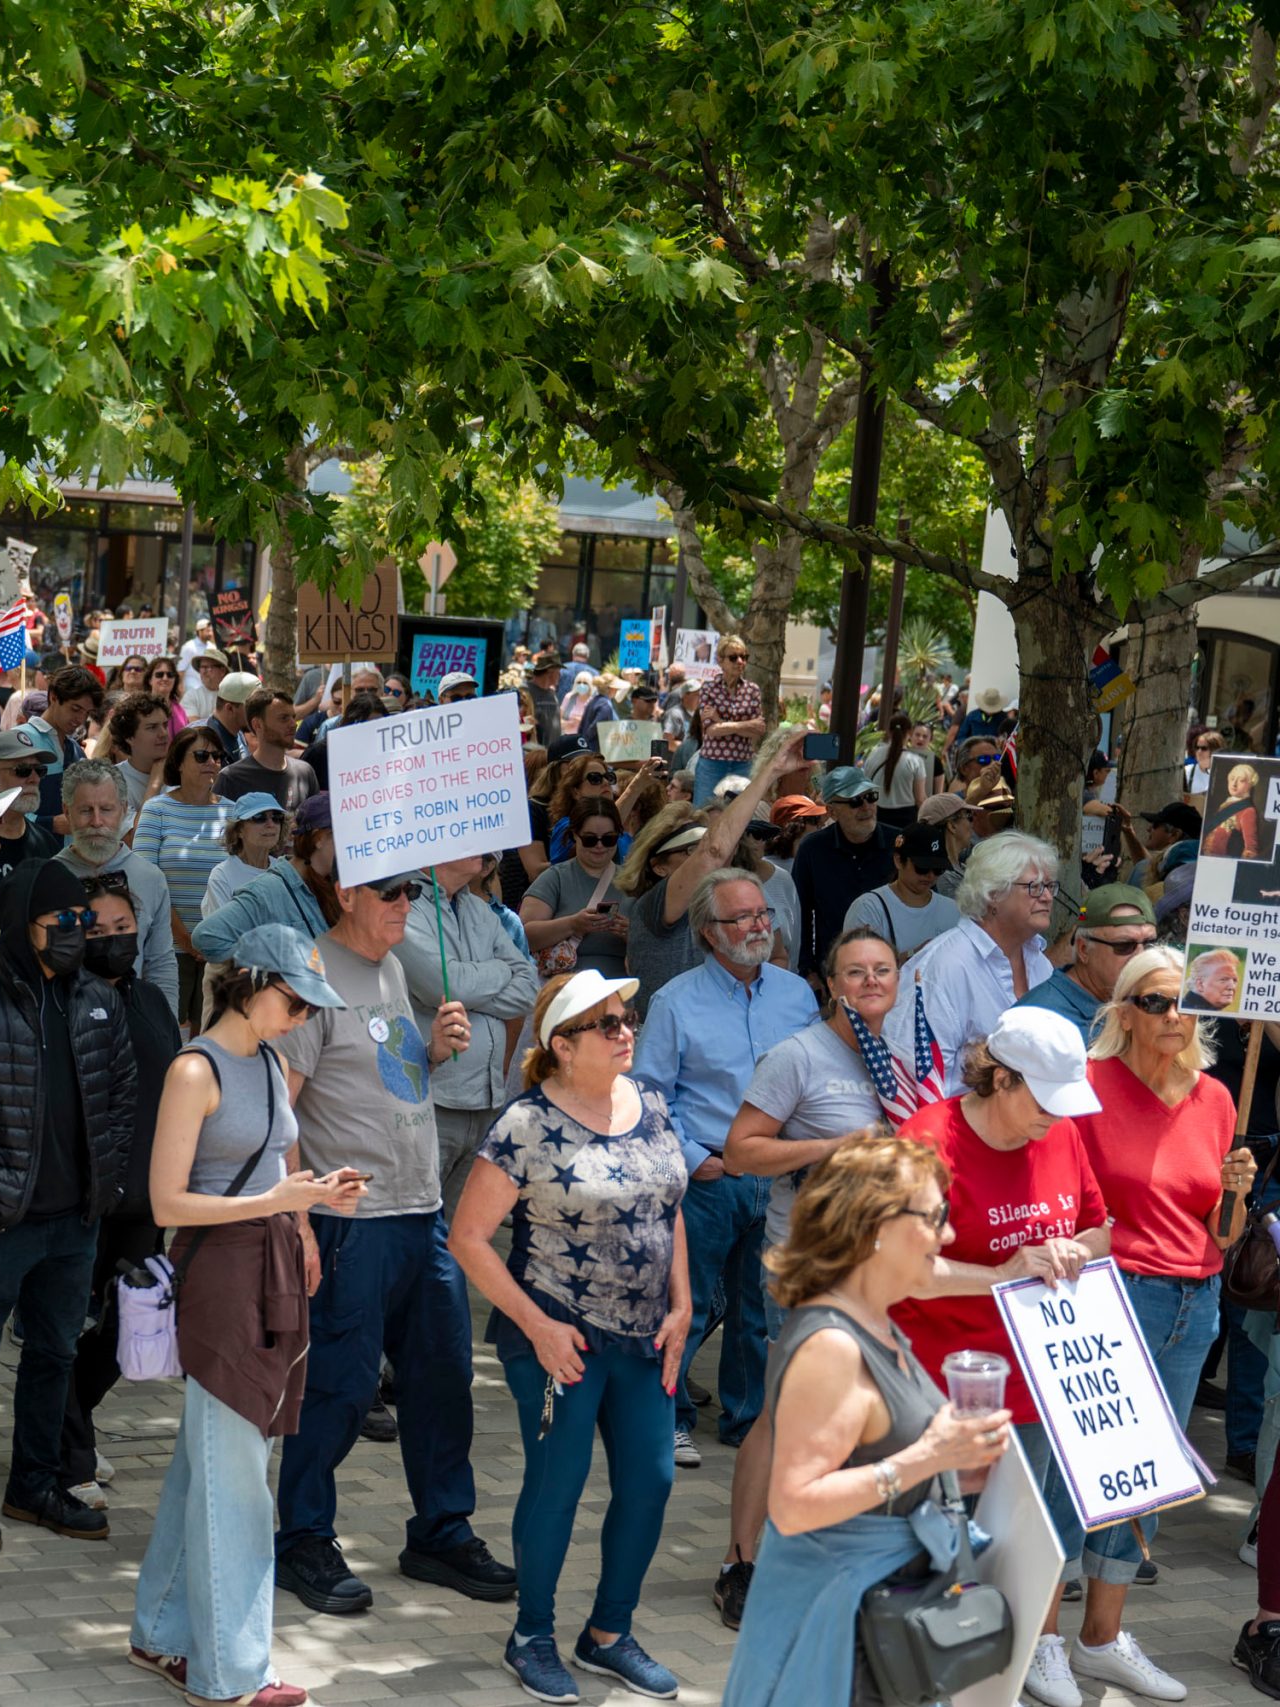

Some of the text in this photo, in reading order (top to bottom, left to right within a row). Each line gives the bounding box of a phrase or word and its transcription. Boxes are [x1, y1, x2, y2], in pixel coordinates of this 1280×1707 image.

[154, 521, 178, 532] 1210
[212, 600, 248, 615] KINGS!
[217, 590, 241, 605] NO
[112, 627, 155, 640] TRUTH
[305, 613, 394, 652] KINGS!
[102, 643, 163, 657] MATTERS
[418, 642, 478, 661] BRIDE
[377, 713, 463, 752] TRUMP
[621, 721, 637, 731] NO
[338, 738, 512, 787] TAKES FROM THE POOR
[340, 763, 513, 812] AND GIVES TO THE RICH
[365, 789, 511, 831] LET'S ROBIN HOOD
[346, 813, 504, 860] THE CRAP OUT OF HIM!
[1195, 904, 1279, 926] We fought
[1191, 921, 1242, 935] dictator
[1245, 926, 1258, 937] in
[1252, 951, 1276, 966] We
[1249, 968, 1280, 982] wha
[1246, 983, 1276, 997] hell
[1244, 998, 1280, 1013] in 20
[988, 1193, 1074, 1225] Silence is
[989, 1218, 1075, 1251] complicity
[1039, 1299, 1076, 1328] NO
[1045, 1333, 1123, 1370] FAUX-
[1059, 1368, 1121, 1405] KING
[1072, 1397, 1139, 1436] WAY!
[1099, 1460, 1158, 1501] 8647
